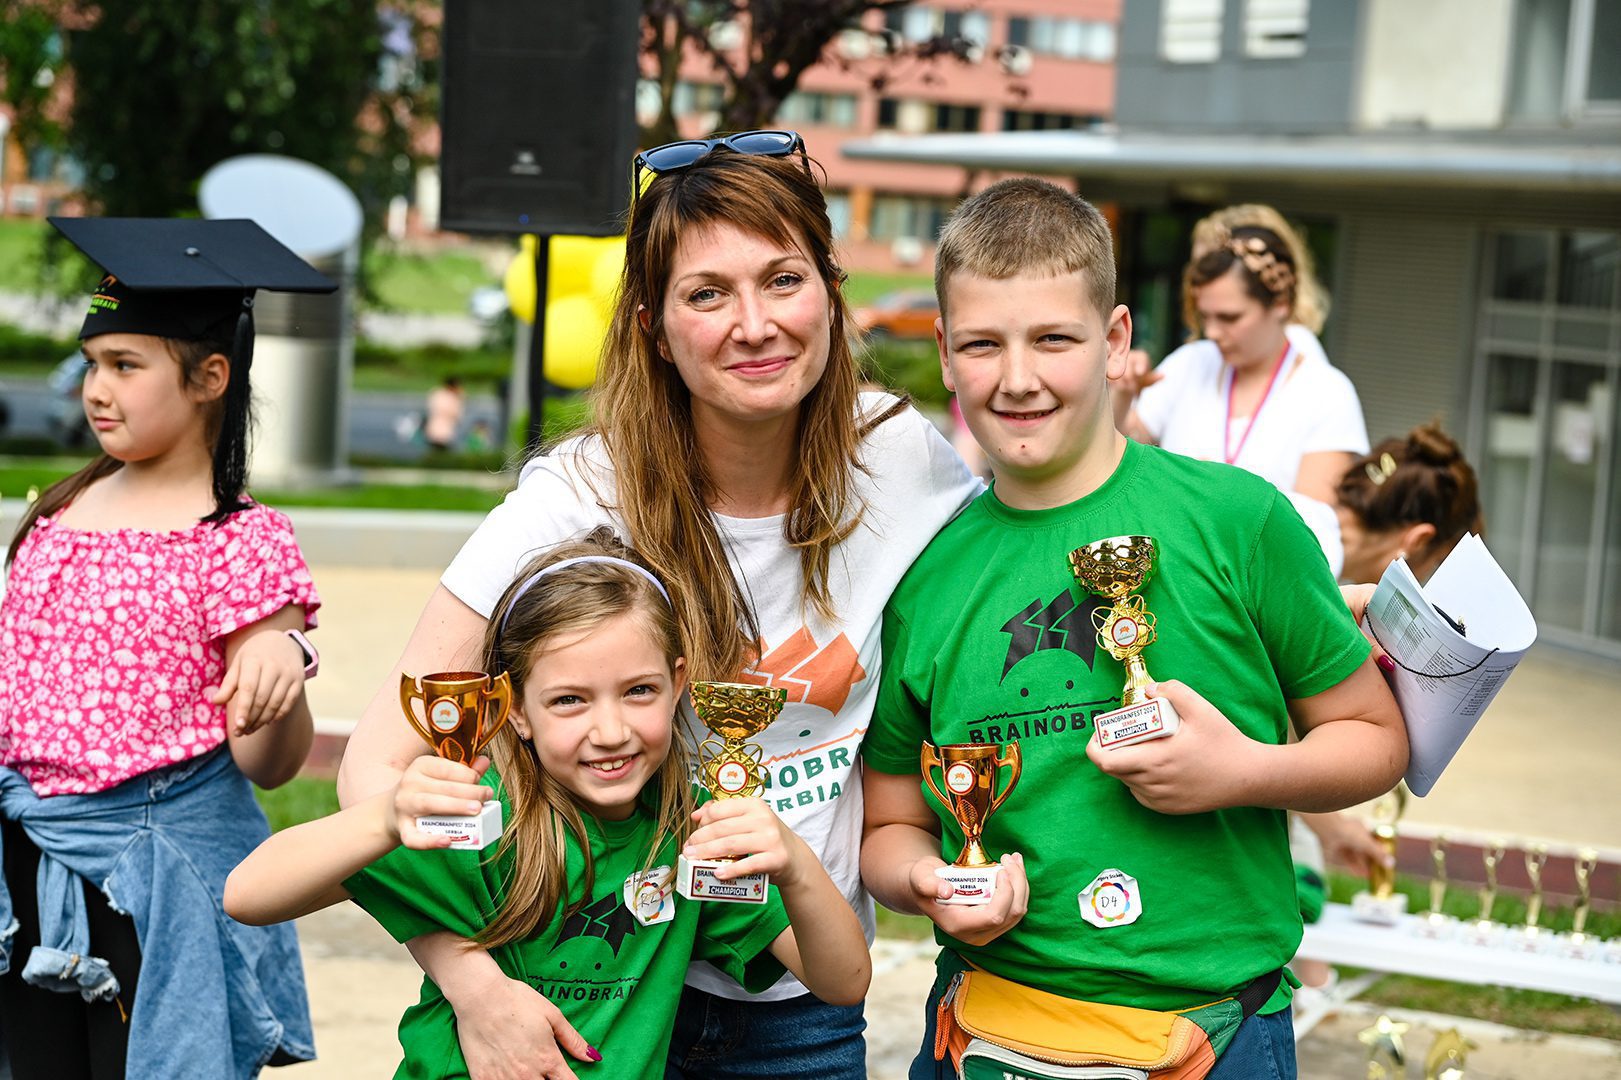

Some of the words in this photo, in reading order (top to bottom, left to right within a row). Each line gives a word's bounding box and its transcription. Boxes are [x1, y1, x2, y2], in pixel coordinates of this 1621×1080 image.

[1100, 710, 1143, 727] BRAINOBRAINFEST
[1143, 705, 1156, 715] 2024
[710, 886, 746, 896] CHAMPION
